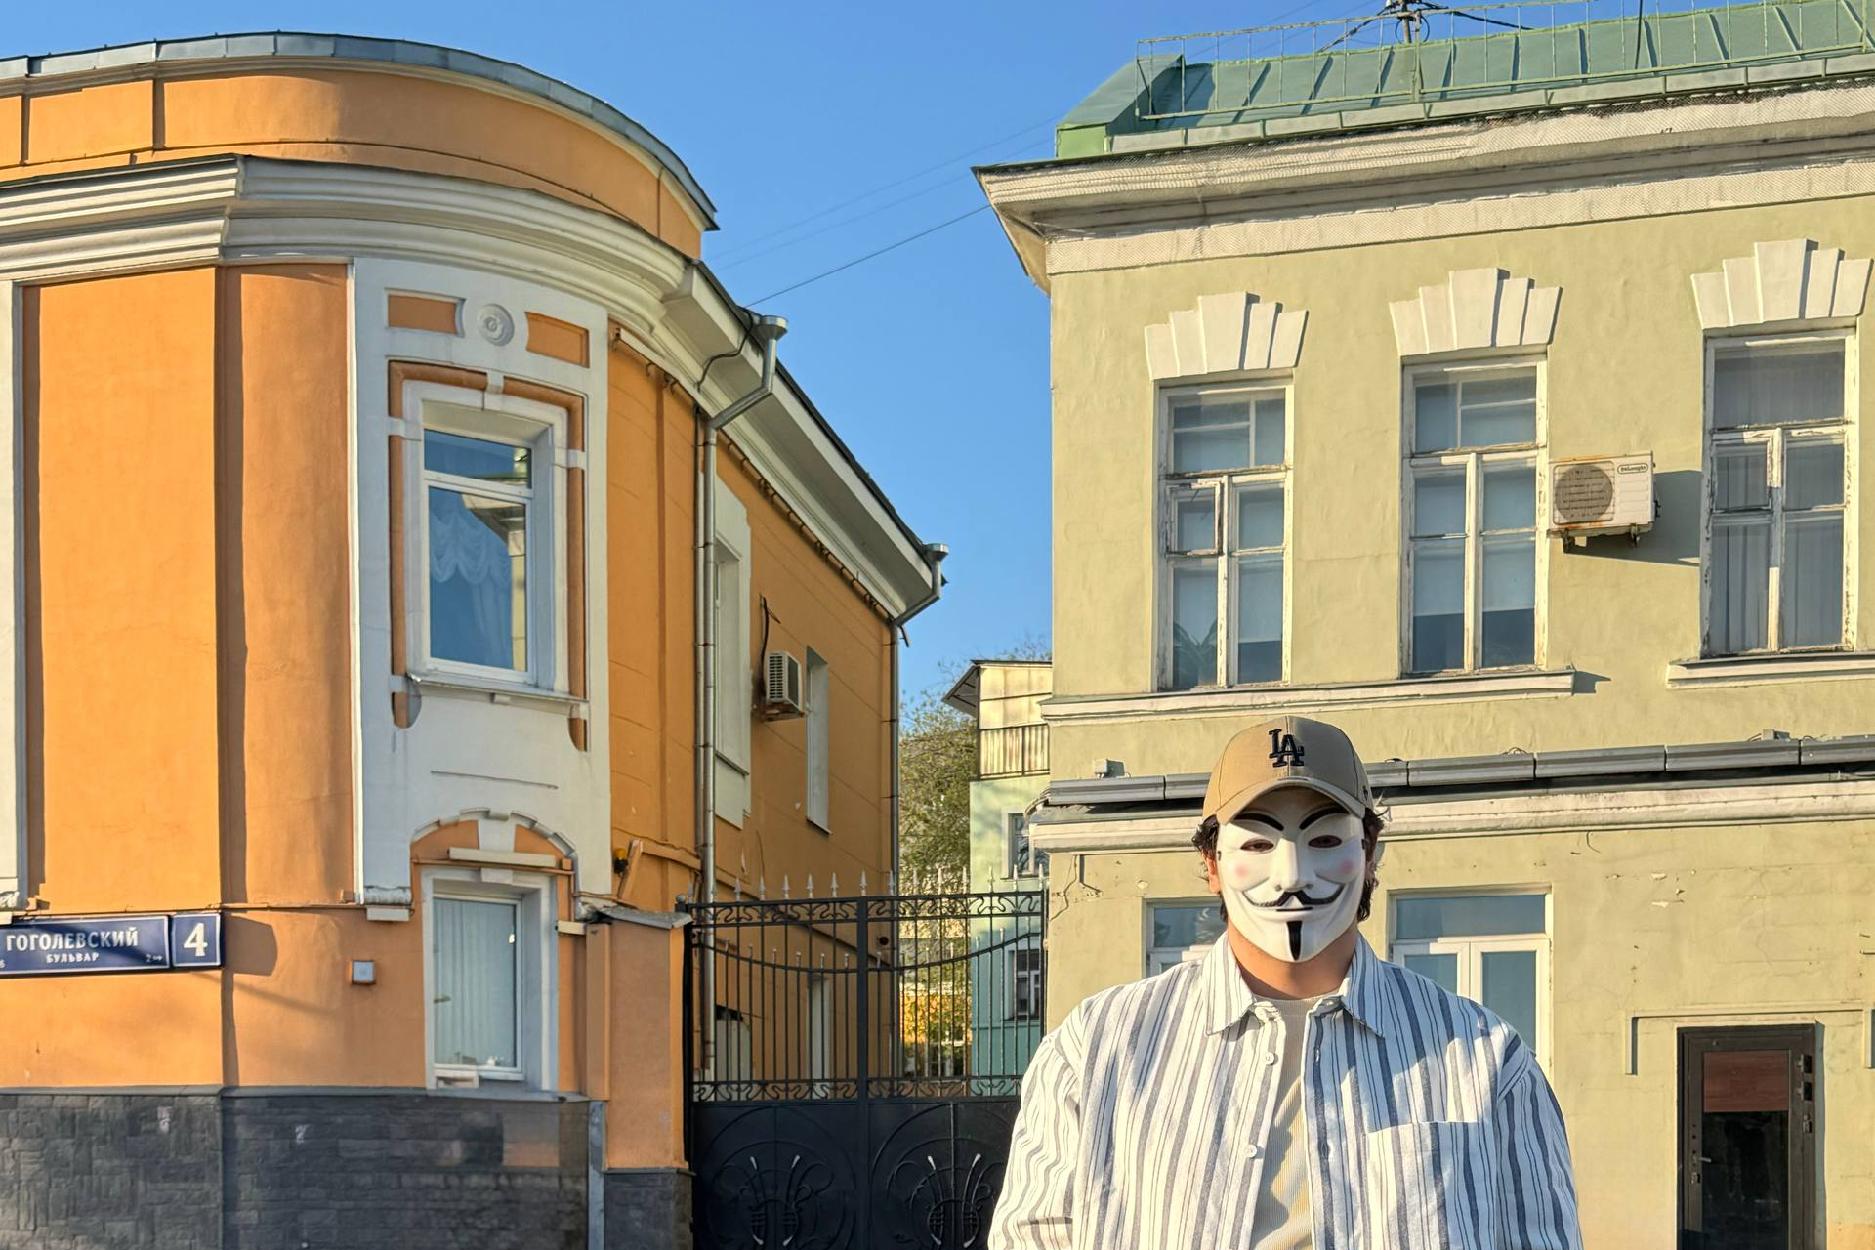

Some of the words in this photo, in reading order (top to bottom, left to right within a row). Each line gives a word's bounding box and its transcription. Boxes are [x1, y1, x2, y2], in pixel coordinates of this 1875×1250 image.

[1269, 729, 1305, 768] LA
[6, 927, 139, 951] ГОГОЛЕВСКИЙ
[183, 922, 208, 957] 4
[46, 952, 99, 964] БУЛЬВАР
